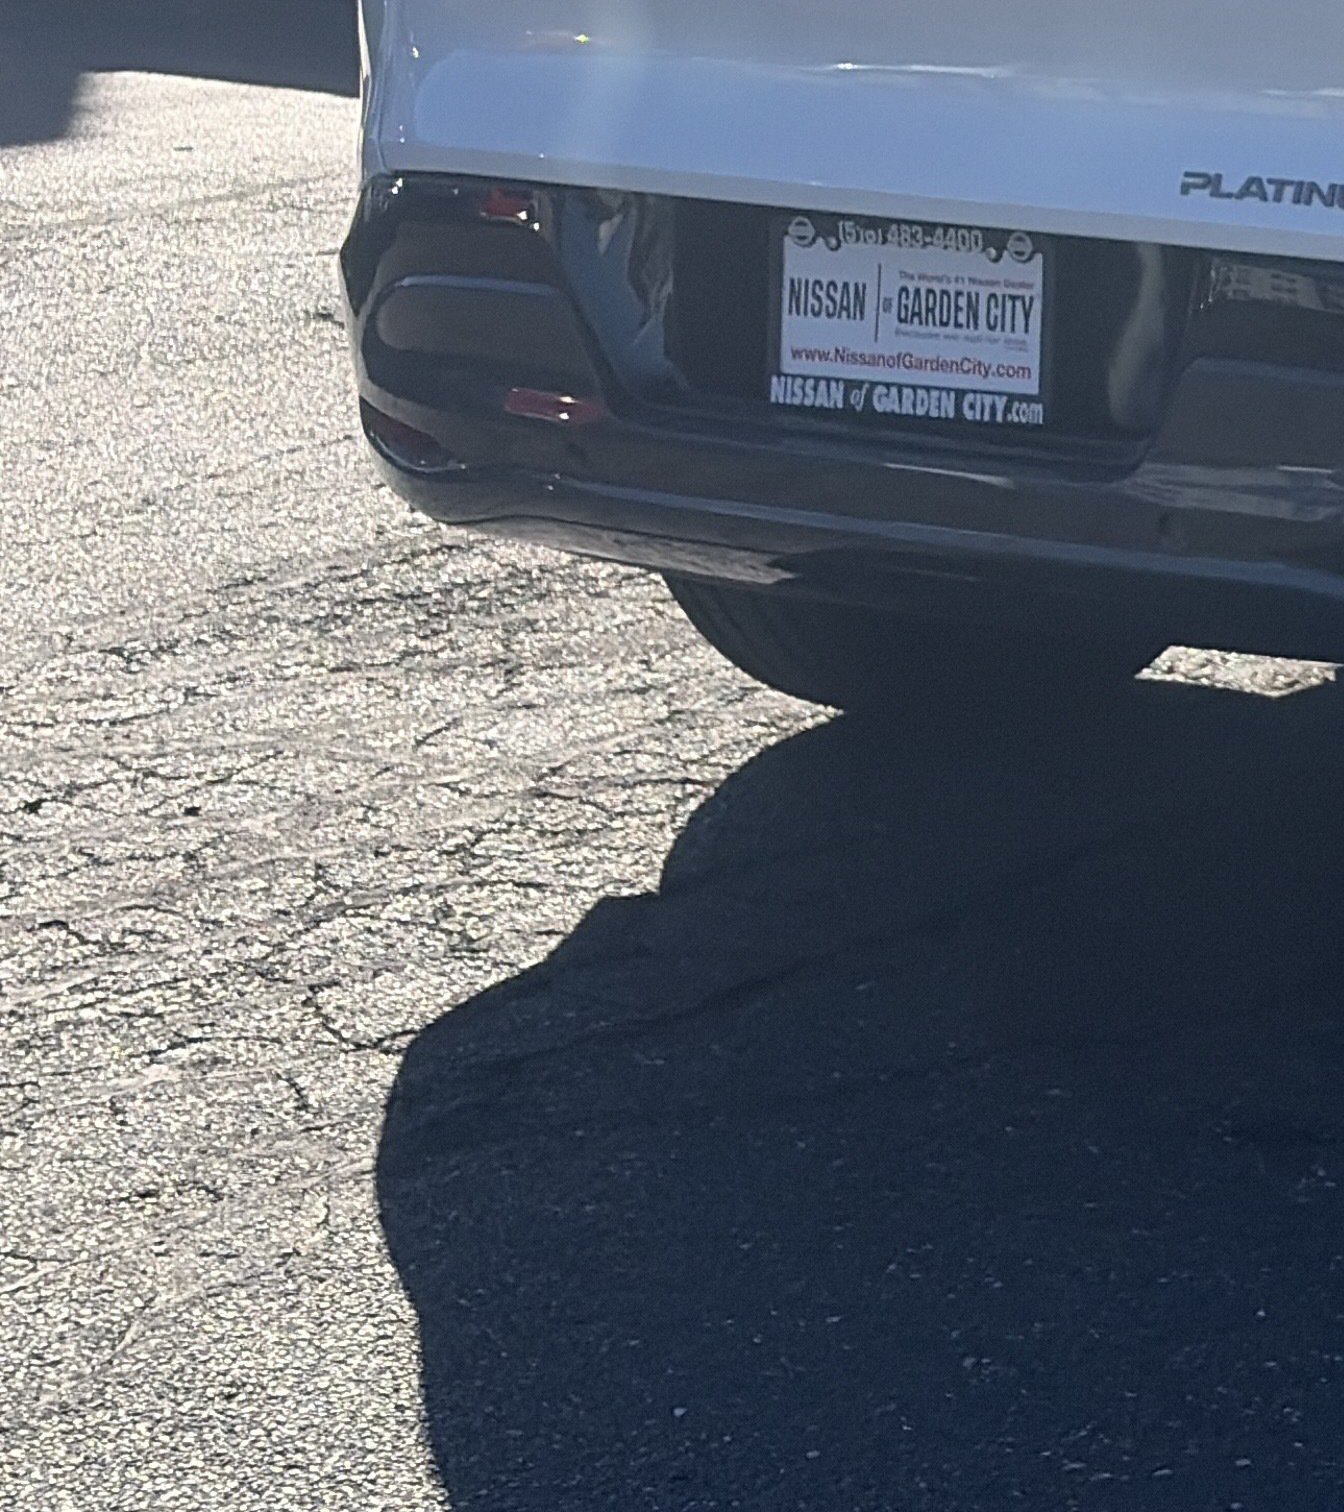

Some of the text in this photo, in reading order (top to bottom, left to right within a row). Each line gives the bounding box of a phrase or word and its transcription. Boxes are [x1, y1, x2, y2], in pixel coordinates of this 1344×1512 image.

[788, 277, 867, 321] NISSAN
[896, 285, 980, 331] GARDEN
[985, 292, 1035, 334] CITY
[790, 345, 1032, 380] www.NissanofGardenCity.com
[769, 374, 1044, 425] NISSAN of GARDEN CITY.com
